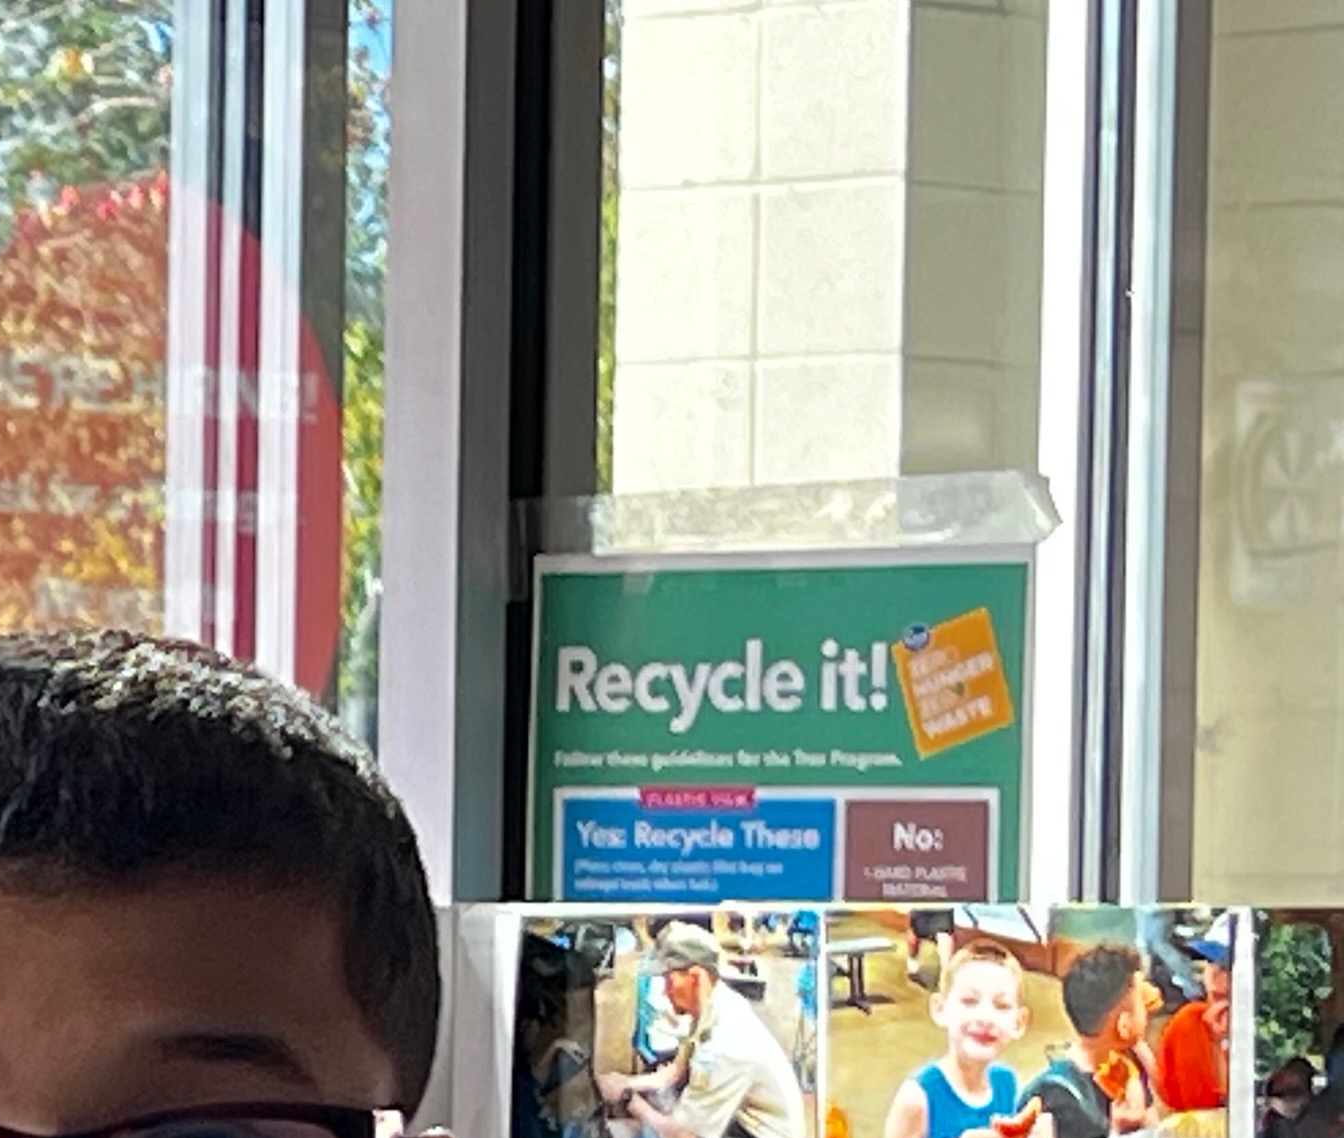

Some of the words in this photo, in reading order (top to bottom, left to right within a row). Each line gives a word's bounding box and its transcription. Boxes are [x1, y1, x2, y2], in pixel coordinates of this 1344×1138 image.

[555, 638, 806, 734] Recycle
[820, 638, 889, 711] it!
[634, 819, 735, 857] Recycle
[740, 820, 821, 850] These
[893, 821, 944, 851] No:
